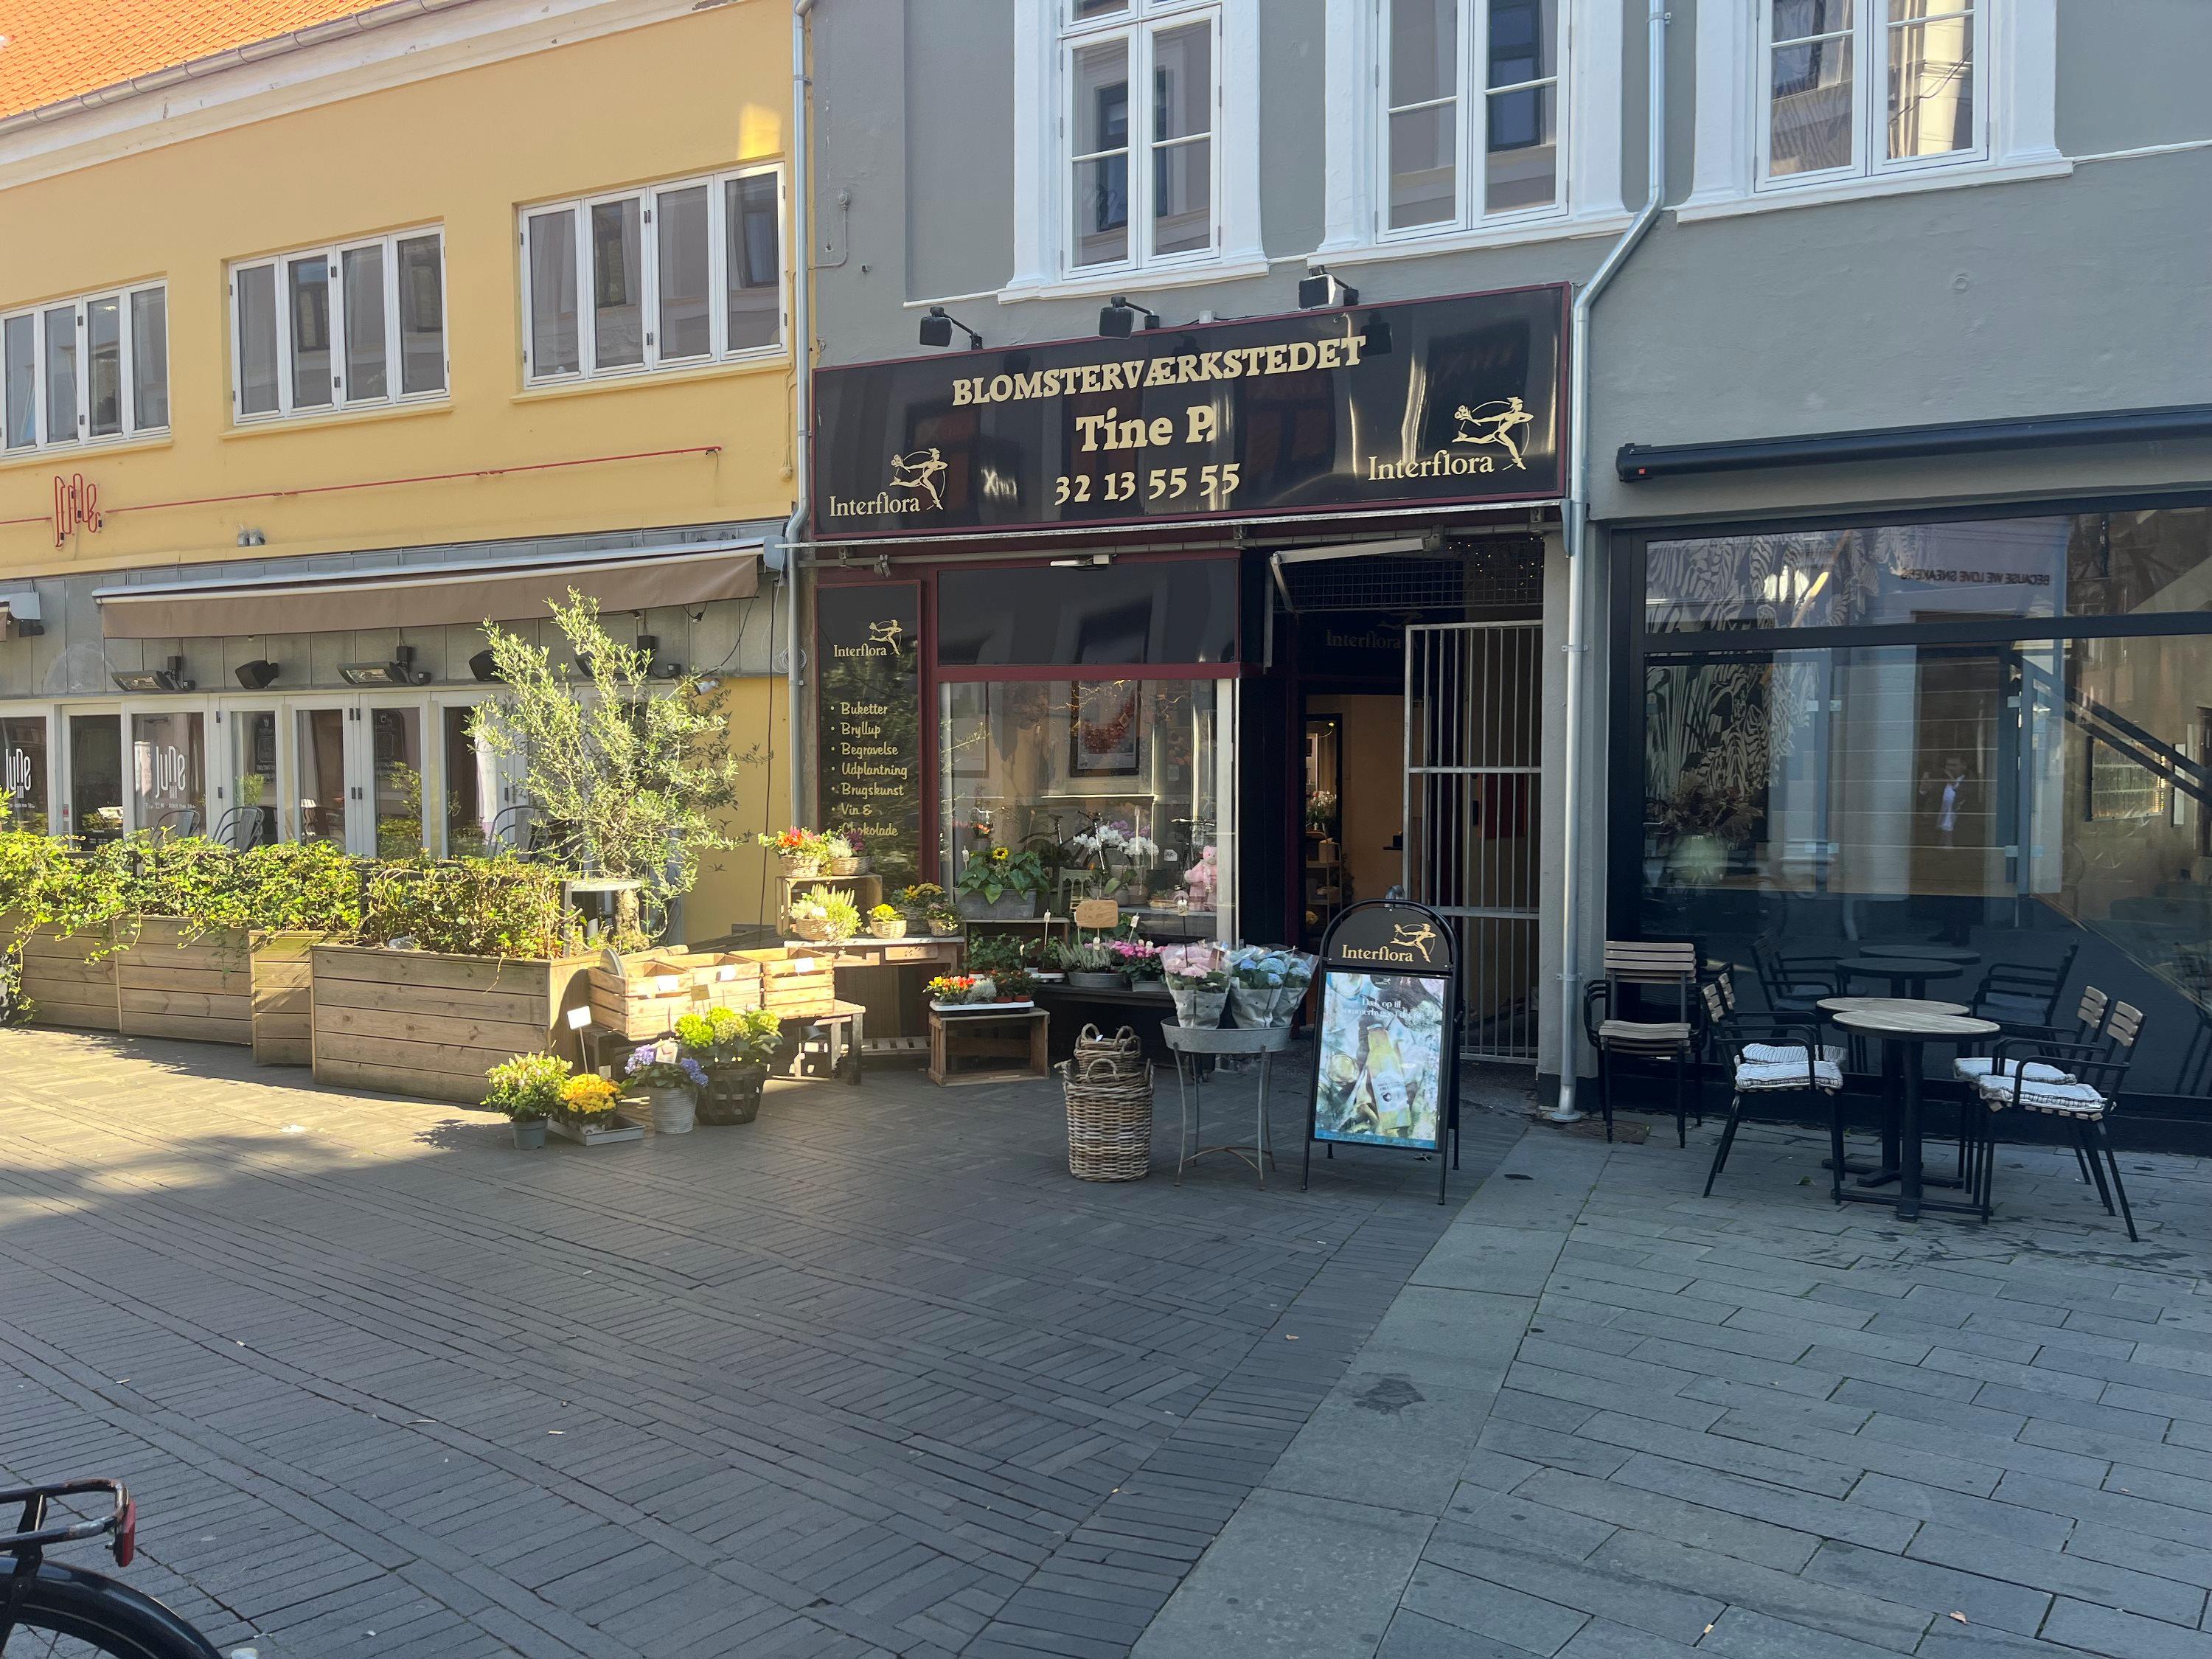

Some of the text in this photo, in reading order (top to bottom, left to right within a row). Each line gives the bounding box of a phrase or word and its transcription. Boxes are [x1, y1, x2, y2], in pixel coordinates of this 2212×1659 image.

[952, 335, 1366, 406] BLOMSTERVÆRKSTEDET
[1076, 406, 1174, 452] Tine
[1368, 449, 1495, 481] Interflora
[1054, 474, 1091, 506] 32
[1104, 471, 1136, 501] 13
[1149, 467, 1188, 500] 55
[1200, 462, 1240, 497] 55
[829, 491, 921, 517] Interflora
[1326, 629, 1401, 649] Interflora
[833, 643, 887, 658] Interflora
[840, 701, 888, 715] Buketter
[840, 721, 881, 740] Bryllup
[840, 741, 899, 759] Begravelse
[841, 761, 908, 780] Udplantning
[841, 782, 905, 800] Brugskunst
[841, 802, 873, 815] Vin &
[841, 821, 899, 836] Chokolade
[1341, 944, 1414, 962] Interflora
